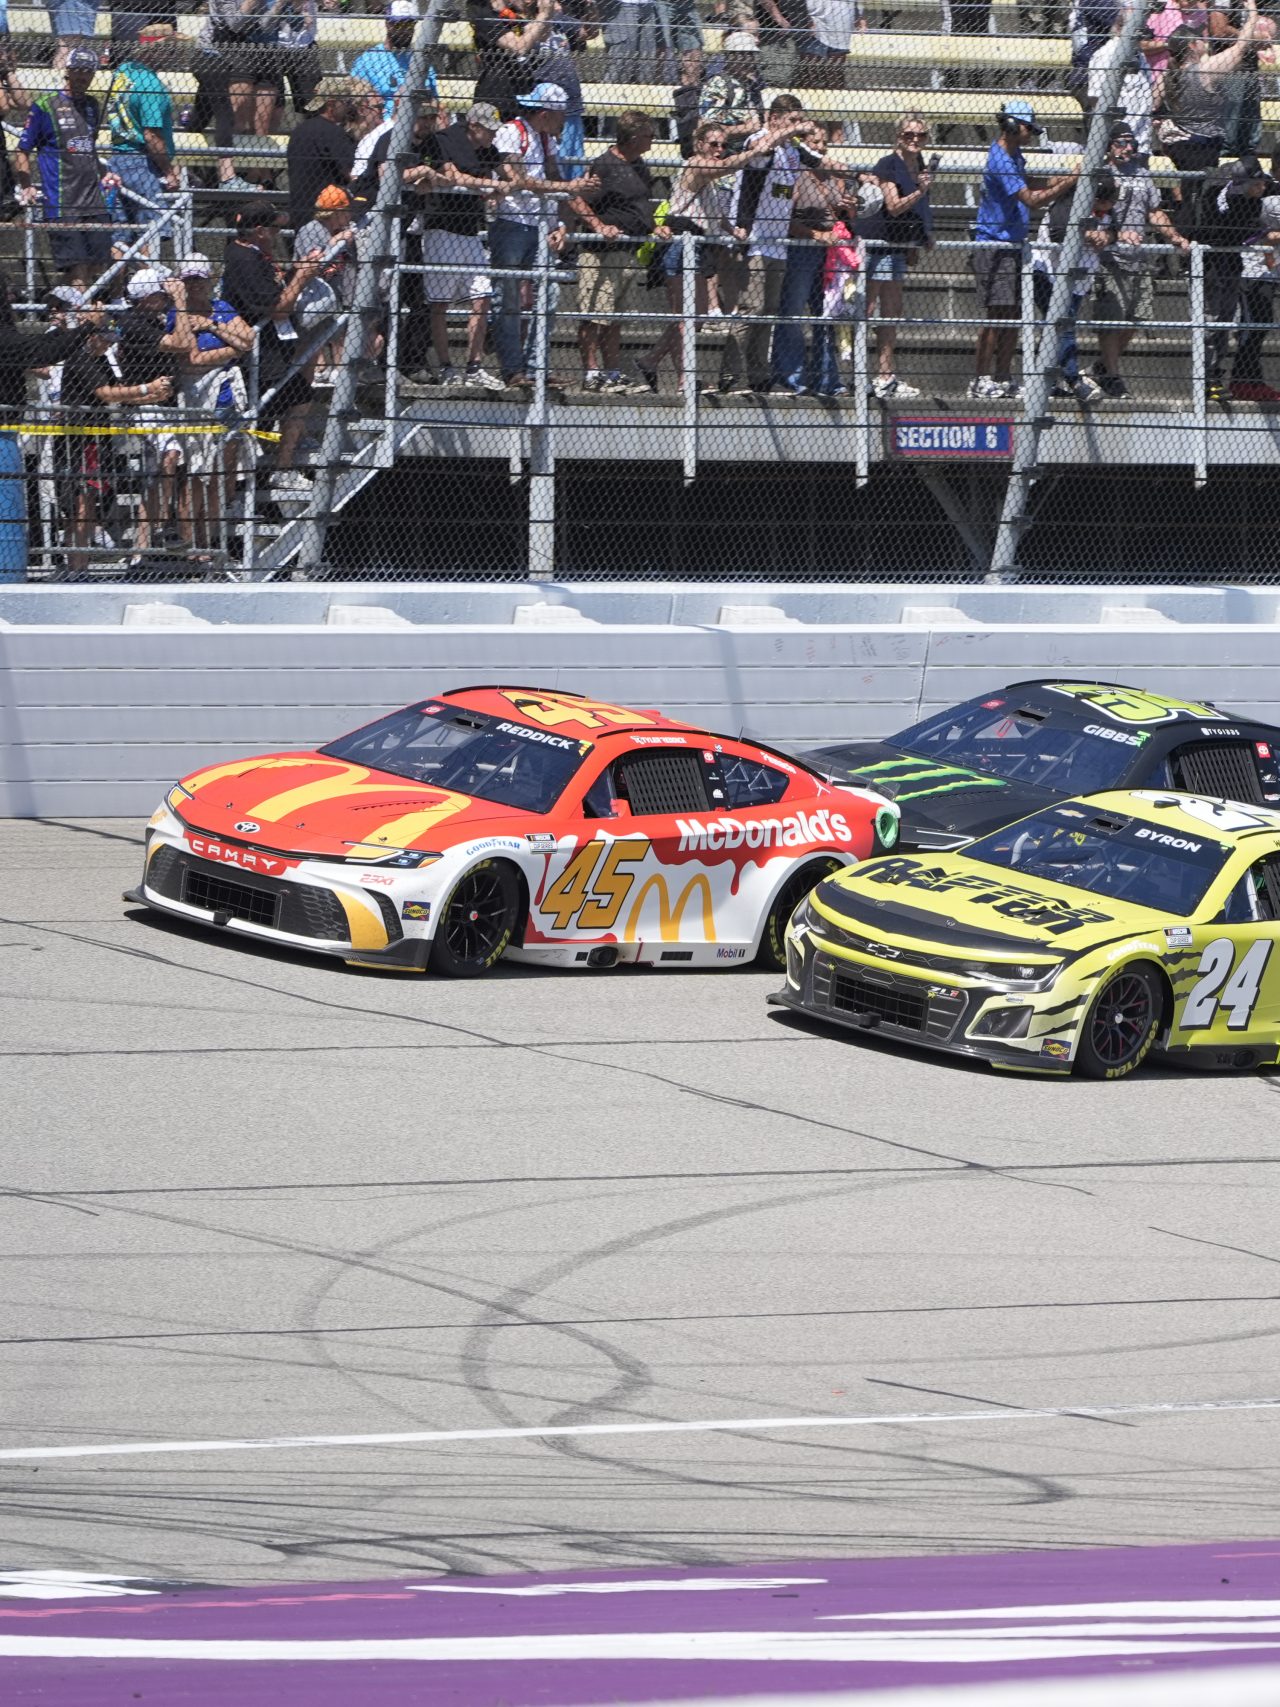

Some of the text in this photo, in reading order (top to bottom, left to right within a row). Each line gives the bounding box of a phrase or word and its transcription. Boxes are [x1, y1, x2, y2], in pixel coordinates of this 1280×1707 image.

[896, 425, 998, 448] SECTION 6
[496, 721, 575, 751] REDDICK
[1083, 724, 1139, 747] GIBBS
[675, 809, 852, 852] McDonald's
[1134, 828, 1202, 853] BYRON
[192, 839, 278, 871] CAMRY
[466, 838, 520, 856] GOODYEAR
[541, 841, 652, 931] 45
[402, 906, 430, 916] SUNOCO
[716, 948, 737, 959] Mobil
[1107, 940, 1160, 960] GOODYEAR
[1180, 938, 1274, 1031] 24
[1043, 1045, 1069, 1055] SUNOCO
[1106, 1018, 1159, 1079] GOODYEAR
